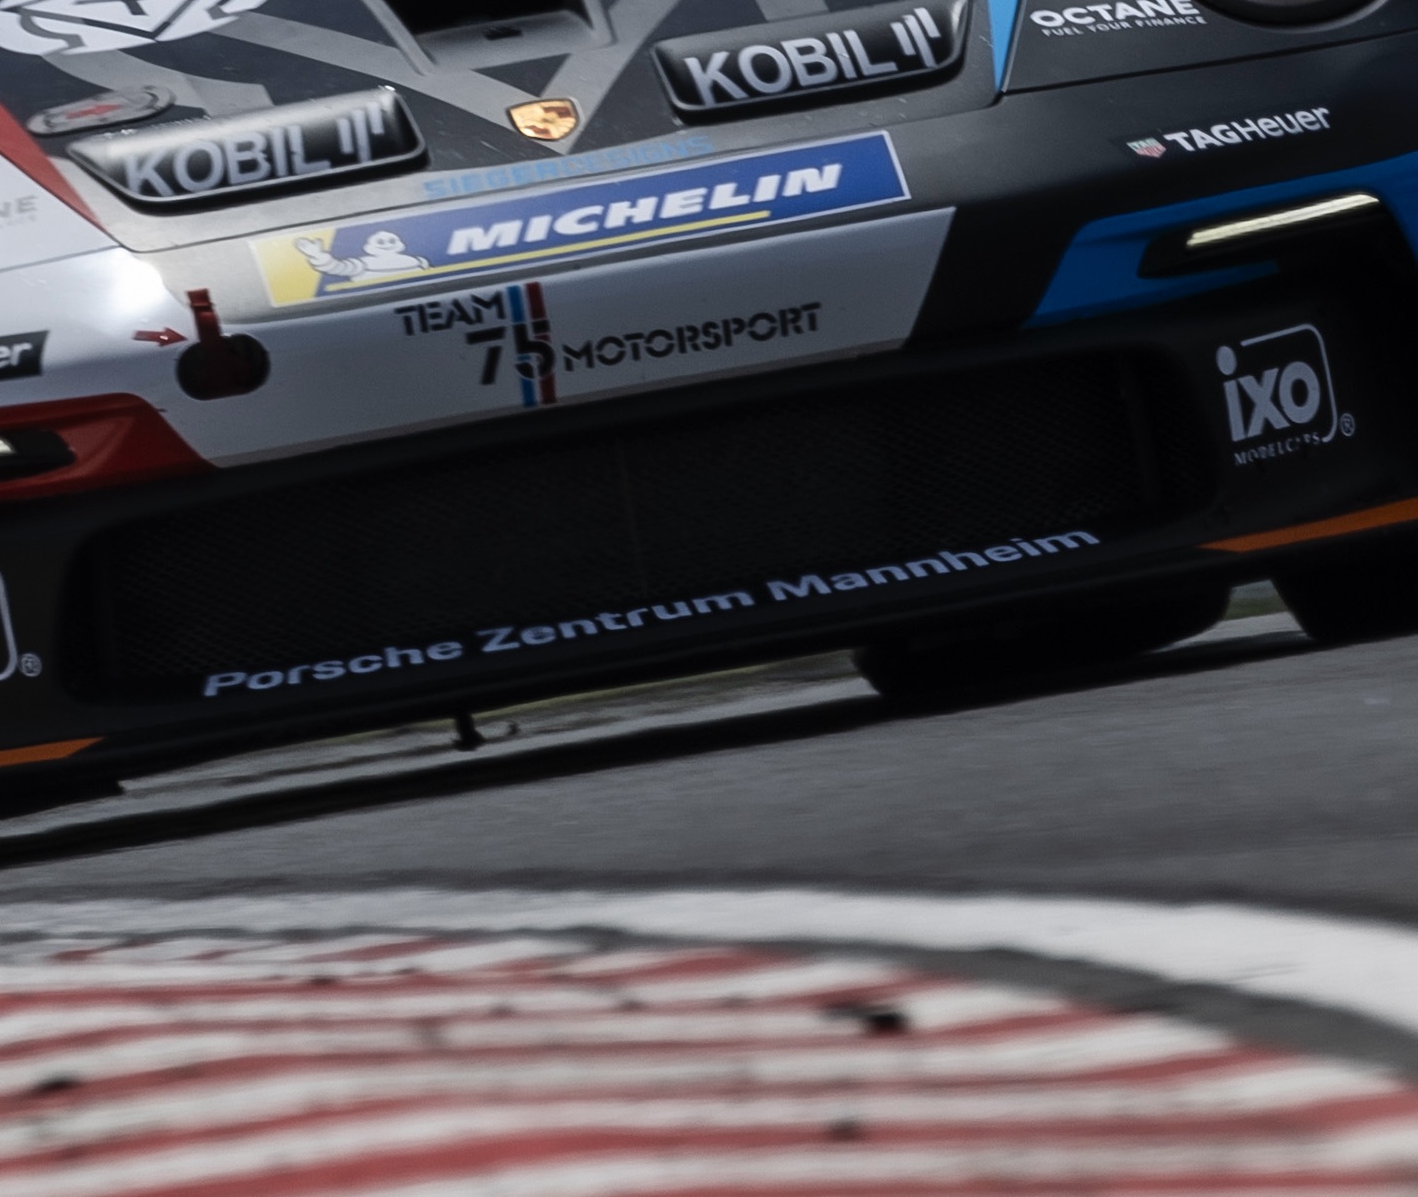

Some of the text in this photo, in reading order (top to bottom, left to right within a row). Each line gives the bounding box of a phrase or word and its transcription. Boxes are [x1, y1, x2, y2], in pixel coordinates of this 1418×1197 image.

[1042, 15, 1209, 38] FUEL YOUR FINANCE
[683, 28, 899, 105] KOBIL
[126, 123, 331, 198] KOBIL
[446, 163, 843, 257] MICHELIN
[394, 288, 507, 336] TEAM
[562, 302, 823, 373] MOTORSPORT
[202, 529, 1101, 696] Porsche Zentrum Mannheim
